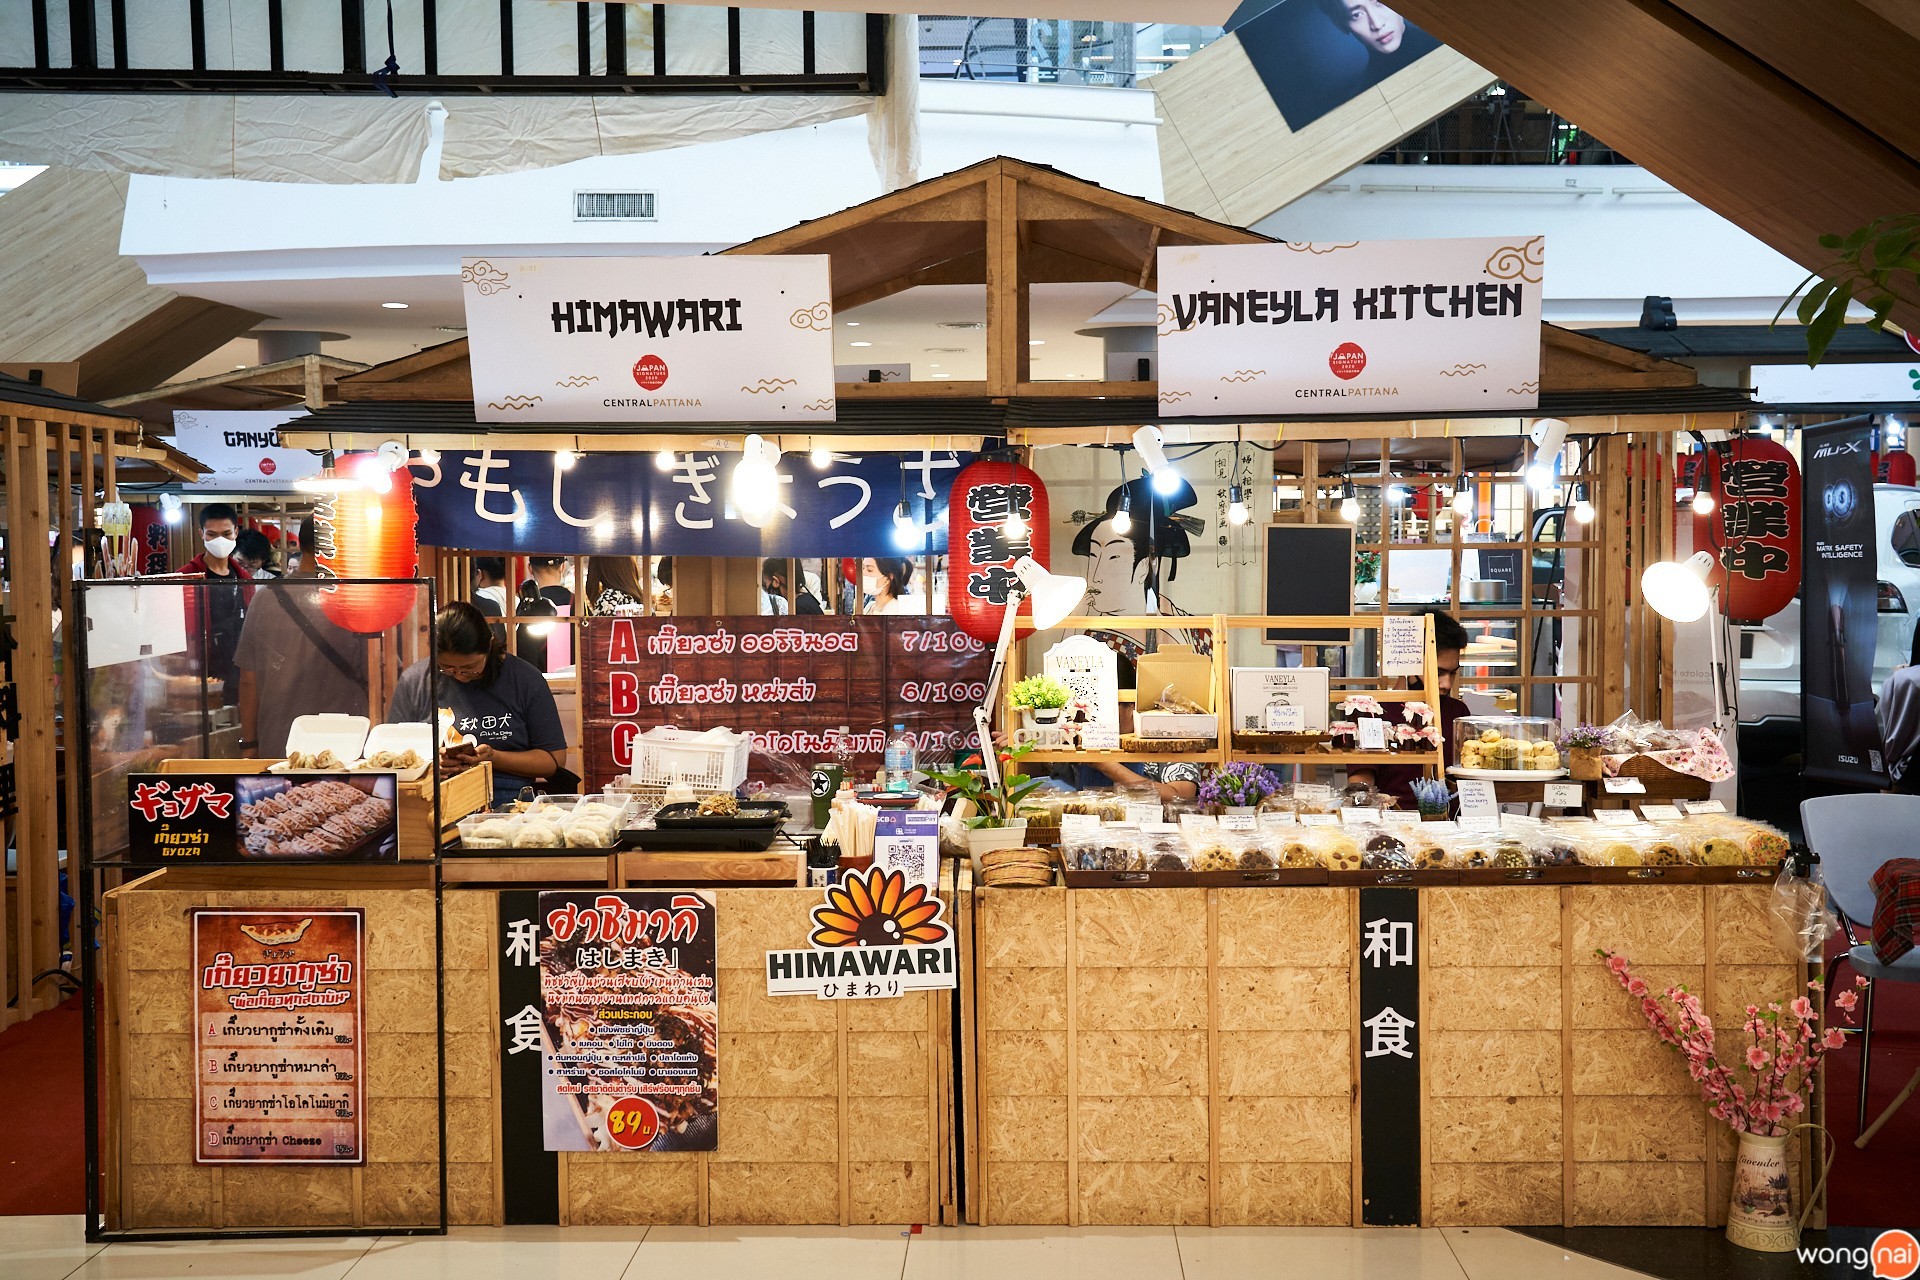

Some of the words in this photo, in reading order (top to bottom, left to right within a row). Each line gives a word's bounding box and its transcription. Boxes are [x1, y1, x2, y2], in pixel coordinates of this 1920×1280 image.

[1172, 285, 1339, 331] VANEYLA
[1352, 281, 1523, 321] KITCHEN
[551, 298, 743, 338] HIMAWARI
[1333, 352, 1364, 361] JAPAN
[636, 364, 666, 372] JAPAN
[1295, 387, 1399, 398] CENTRALPATTANA
[603, 399, 702, 408] CENTRALPATTANA
[1813, 440, 1862, 459] MU-X
[609, 619, 640, 664] A
[901, 630, 986, 653] 7/100
[1055, 656, 1104, 668] VANEYLA
[1265, 674, 1296, 683] VANEYLA
[609, 671, 640, 717] B
[899, 682, 987, 703] 6/100
[460, 713, 512, 730] 秋田犬
[611, 721, 641, 767] C
[1838, 755, 1858, 764] ISUZU
[130, 781, 234, 822] ギョザマ
[162, 848, 200, 857] GYOZA
[769, 947, 952, 979] HIMAWARI
[823, 980, 898, 998] ひまわり
[1363, 917, 1416, 1058] 和食
[208, 1059, 218, 1074] B
[209, 1096, 219, 1110] C
[609, 1110, 642, 1134] 89
[208, 1132, 219, 1146] D
